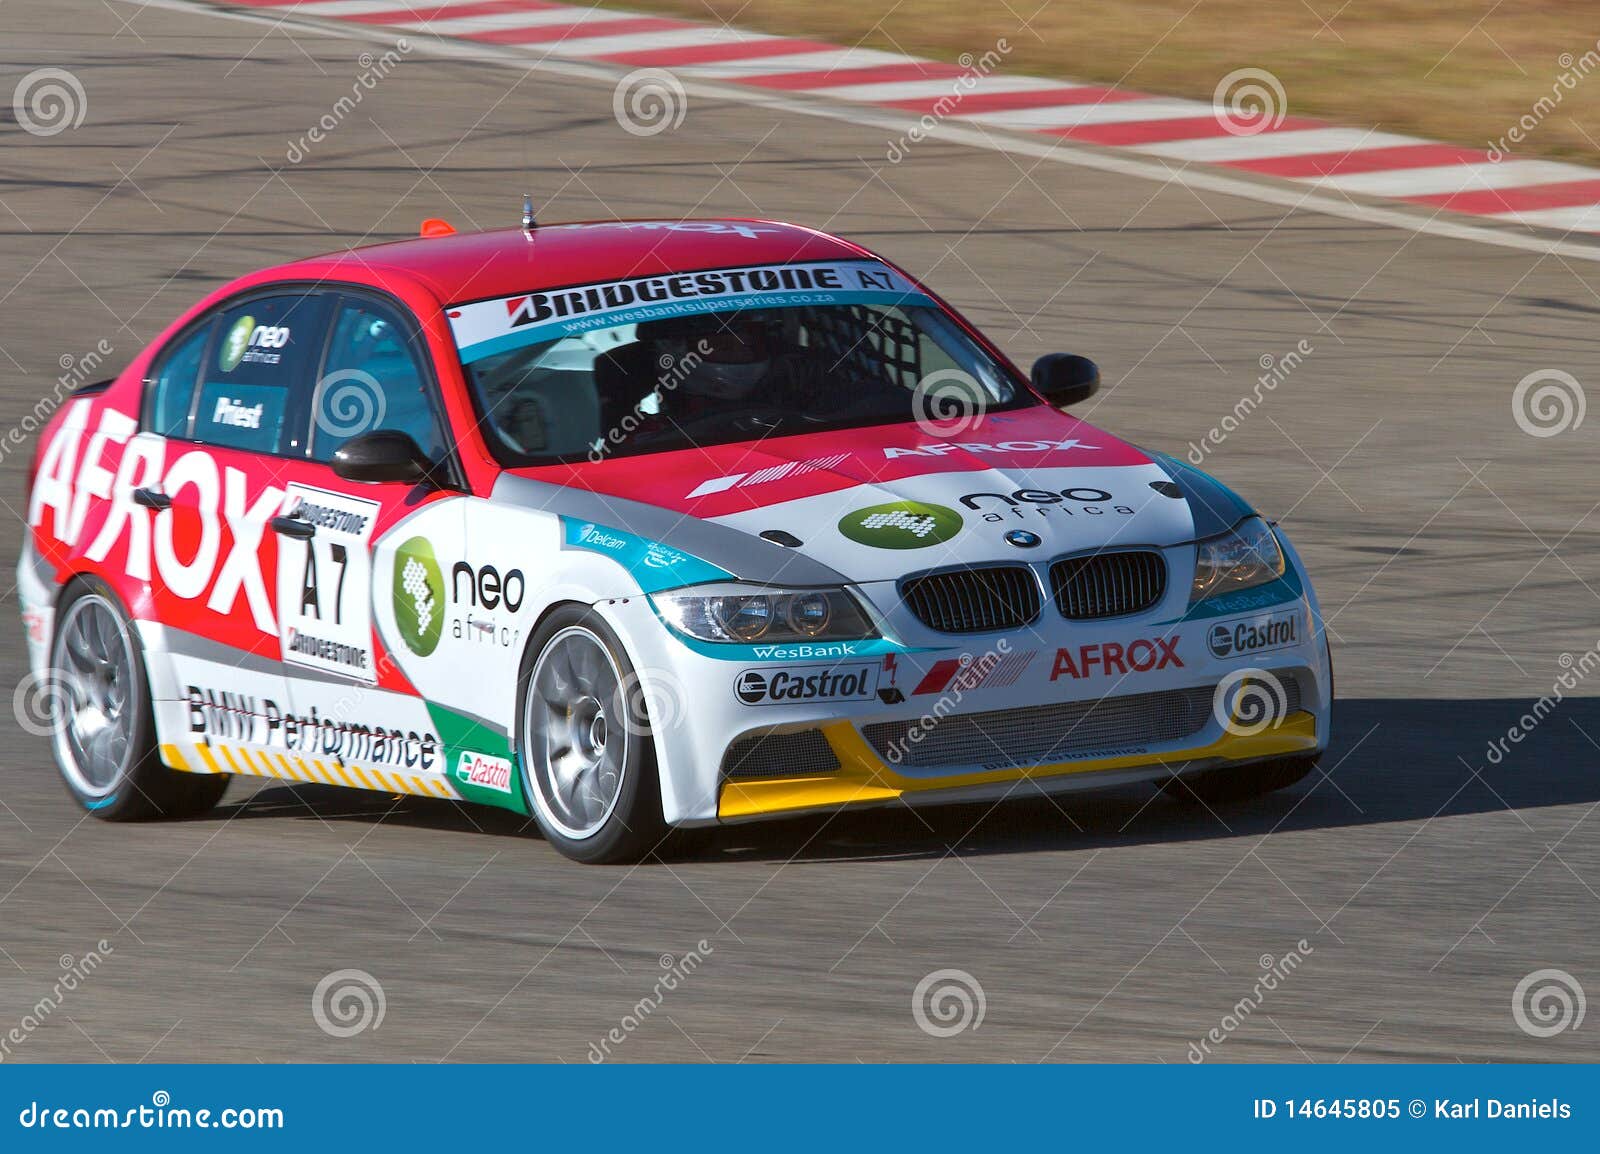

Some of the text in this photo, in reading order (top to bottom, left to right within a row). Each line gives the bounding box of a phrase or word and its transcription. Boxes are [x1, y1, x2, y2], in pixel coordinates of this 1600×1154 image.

[857, 269, 896, 291] A7
[507, 267, 843, 328] BRIDGESTONE
[561, 292, 836, 333] www.wesbanksuperseries.co.za
[248, 325, 290, 348] neo
[882, 438, 1105, 459] AFROX
[959, 487, 1113, 510] neo
[982, 504, 1136, 523] africa
[28, 398, 280, 638] AFROX
[586, 530, 627, 550] Delcam
[452, 560, 525, 613] neo
[287, 626, 367, 669] BRIDGESTONE
[1235, 615, 1296, 652] Castrol
[752, 643, 857, 659] WesBank
[1049, 635, 1185, 681] AFROX
[769, 668, 869, 700] Castrol
[187, 685, 256, 741] BMW
